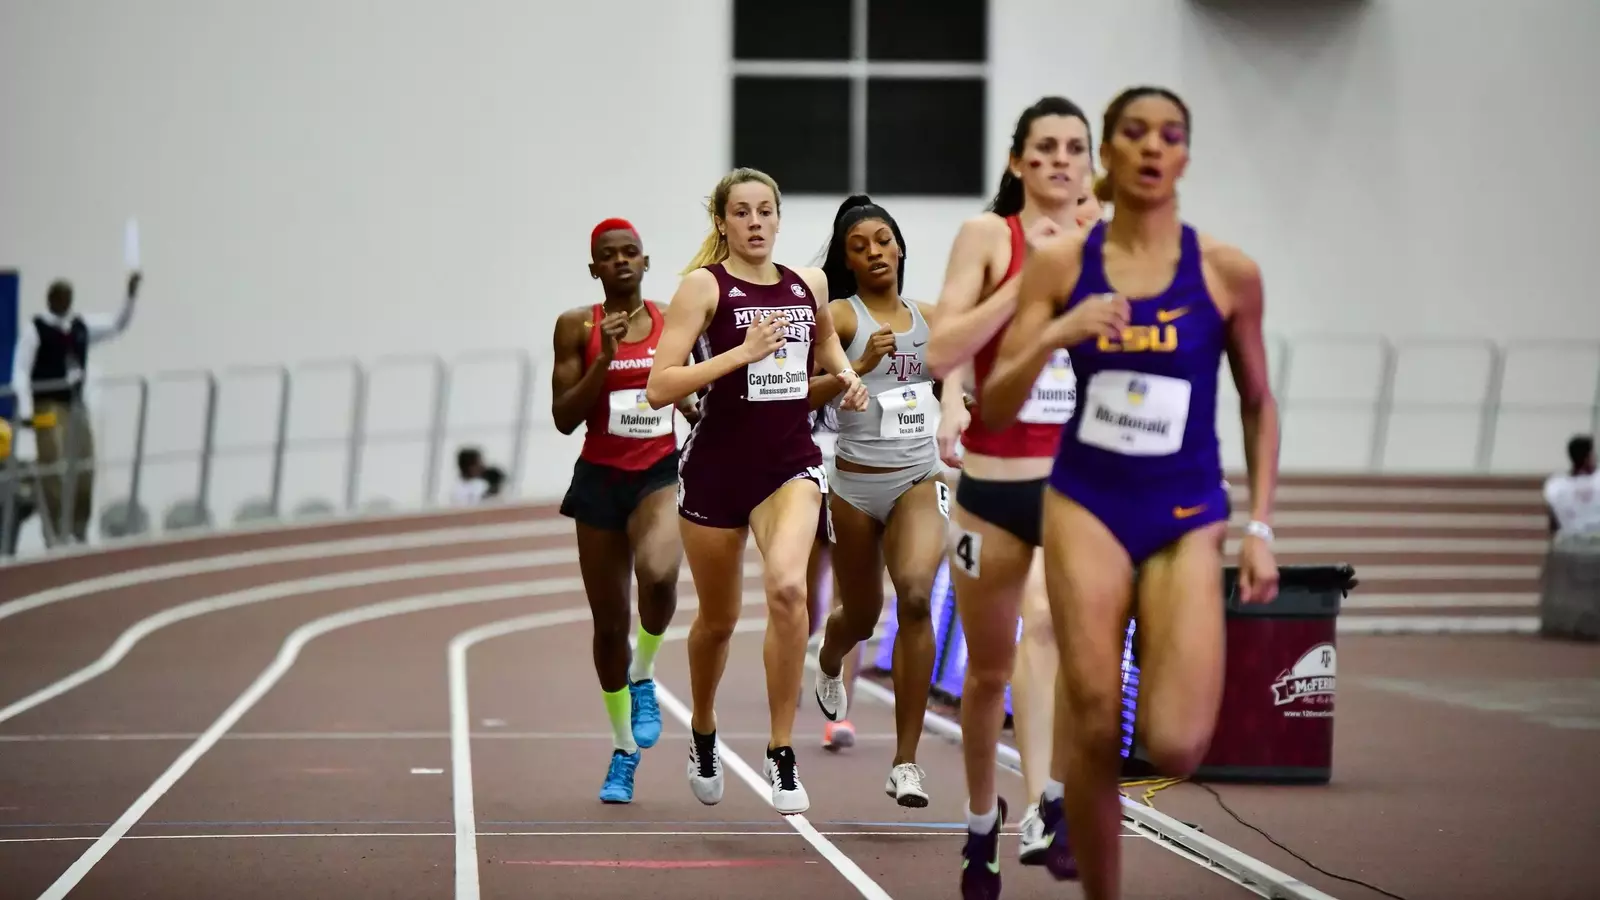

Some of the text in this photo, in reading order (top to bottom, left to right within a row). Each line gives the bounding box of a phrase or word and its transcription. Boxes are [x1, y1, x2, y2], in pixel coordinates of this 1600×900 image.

[734, 308, 816, 325] MISSSIPPI
[608, 358, 653, 370] RKANS
[749, 371, 806, 386] Cayton-Smith
[620, 414, 662, 426] Maloney
[897, 413, 925, 425] Young
[957, 534, 975, 571] 4
